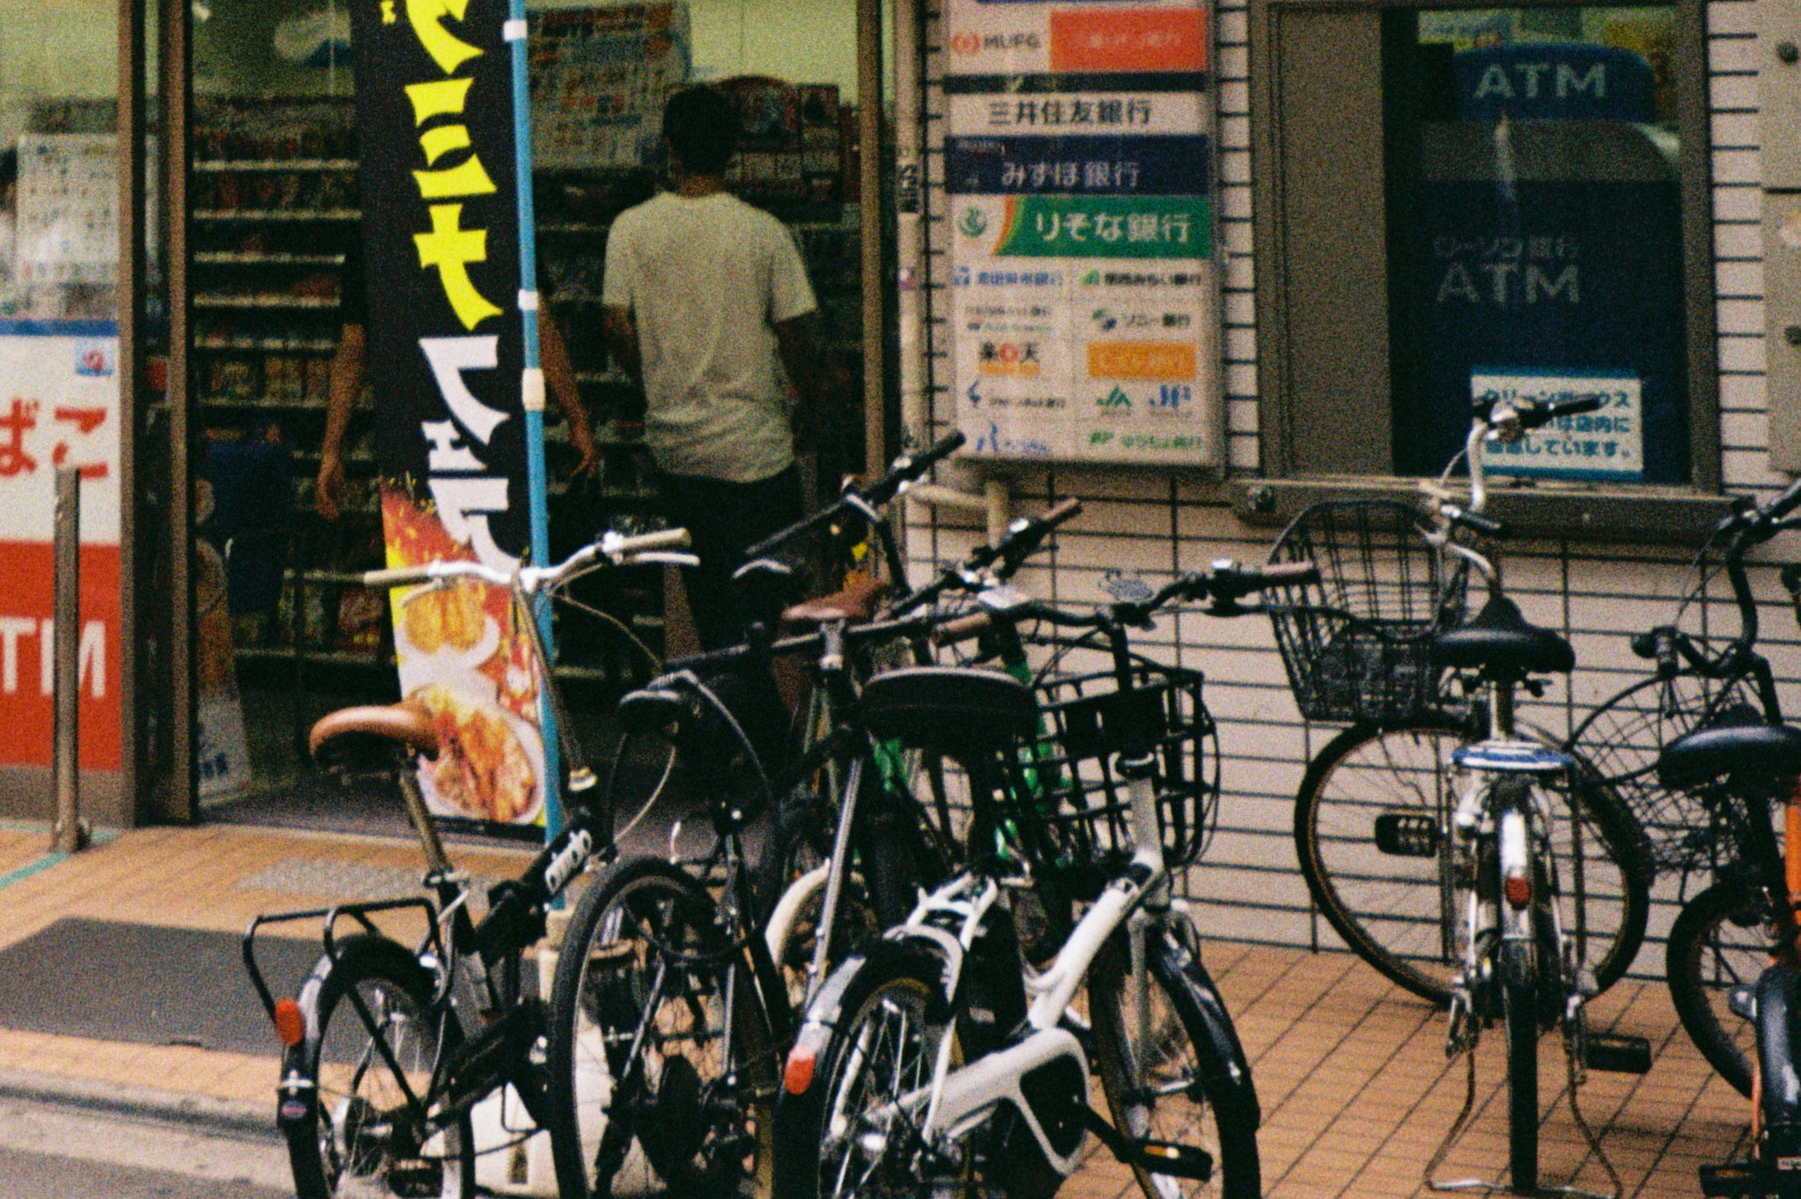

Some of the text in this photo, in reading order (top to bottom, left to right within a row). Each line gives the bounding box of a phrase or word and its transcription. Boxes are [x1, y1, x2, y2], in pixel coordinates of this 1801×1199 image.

[1474, 62, 1606, 99] ATM
[989, 99, 1152, 125] 三井住友銀行
[1001, 161, 1140, 189] みずほ銀行
[1036, 212, 1191, 243] りそな銀行
[1436, 262, 1581, 304] ATM
